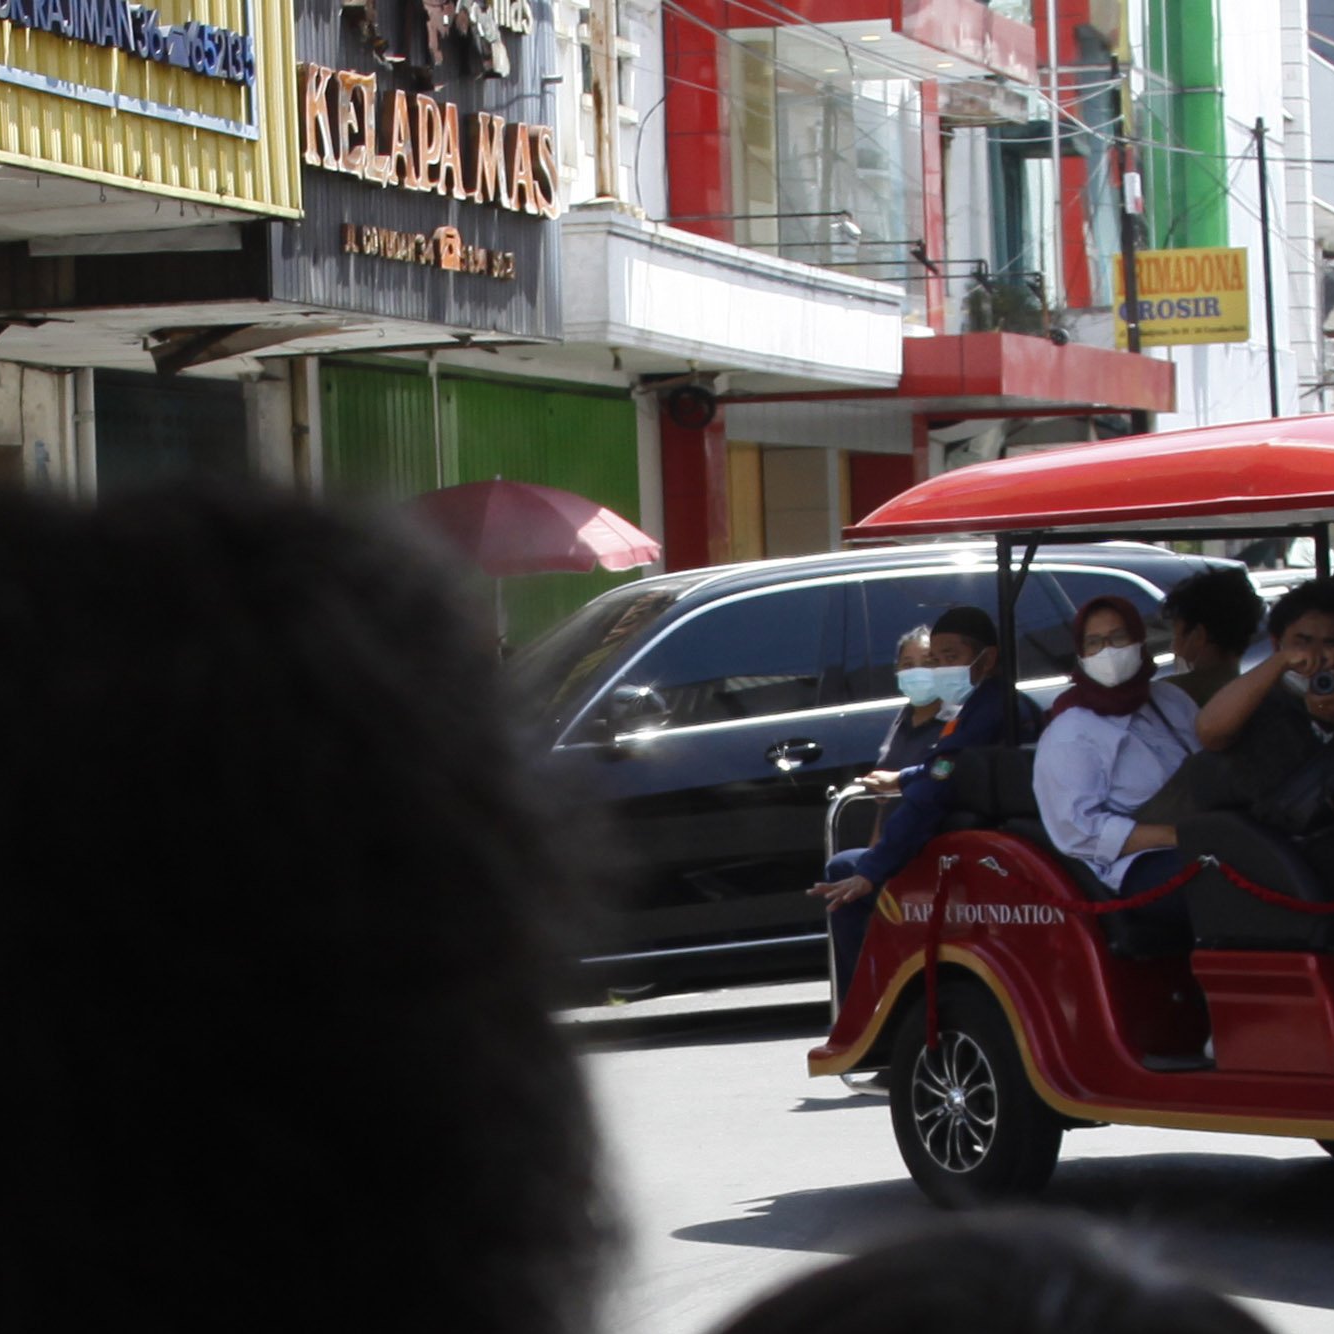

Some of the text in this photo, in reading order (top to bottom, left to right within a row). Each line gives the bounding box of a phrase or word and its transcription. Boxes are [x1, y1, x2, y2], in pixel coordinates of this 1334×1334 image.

[136, 9, 164, 60] 36
[303, 62, 561, 220] KELAPA MAS
[955, 904, 1066, 925] FOUNDATION
